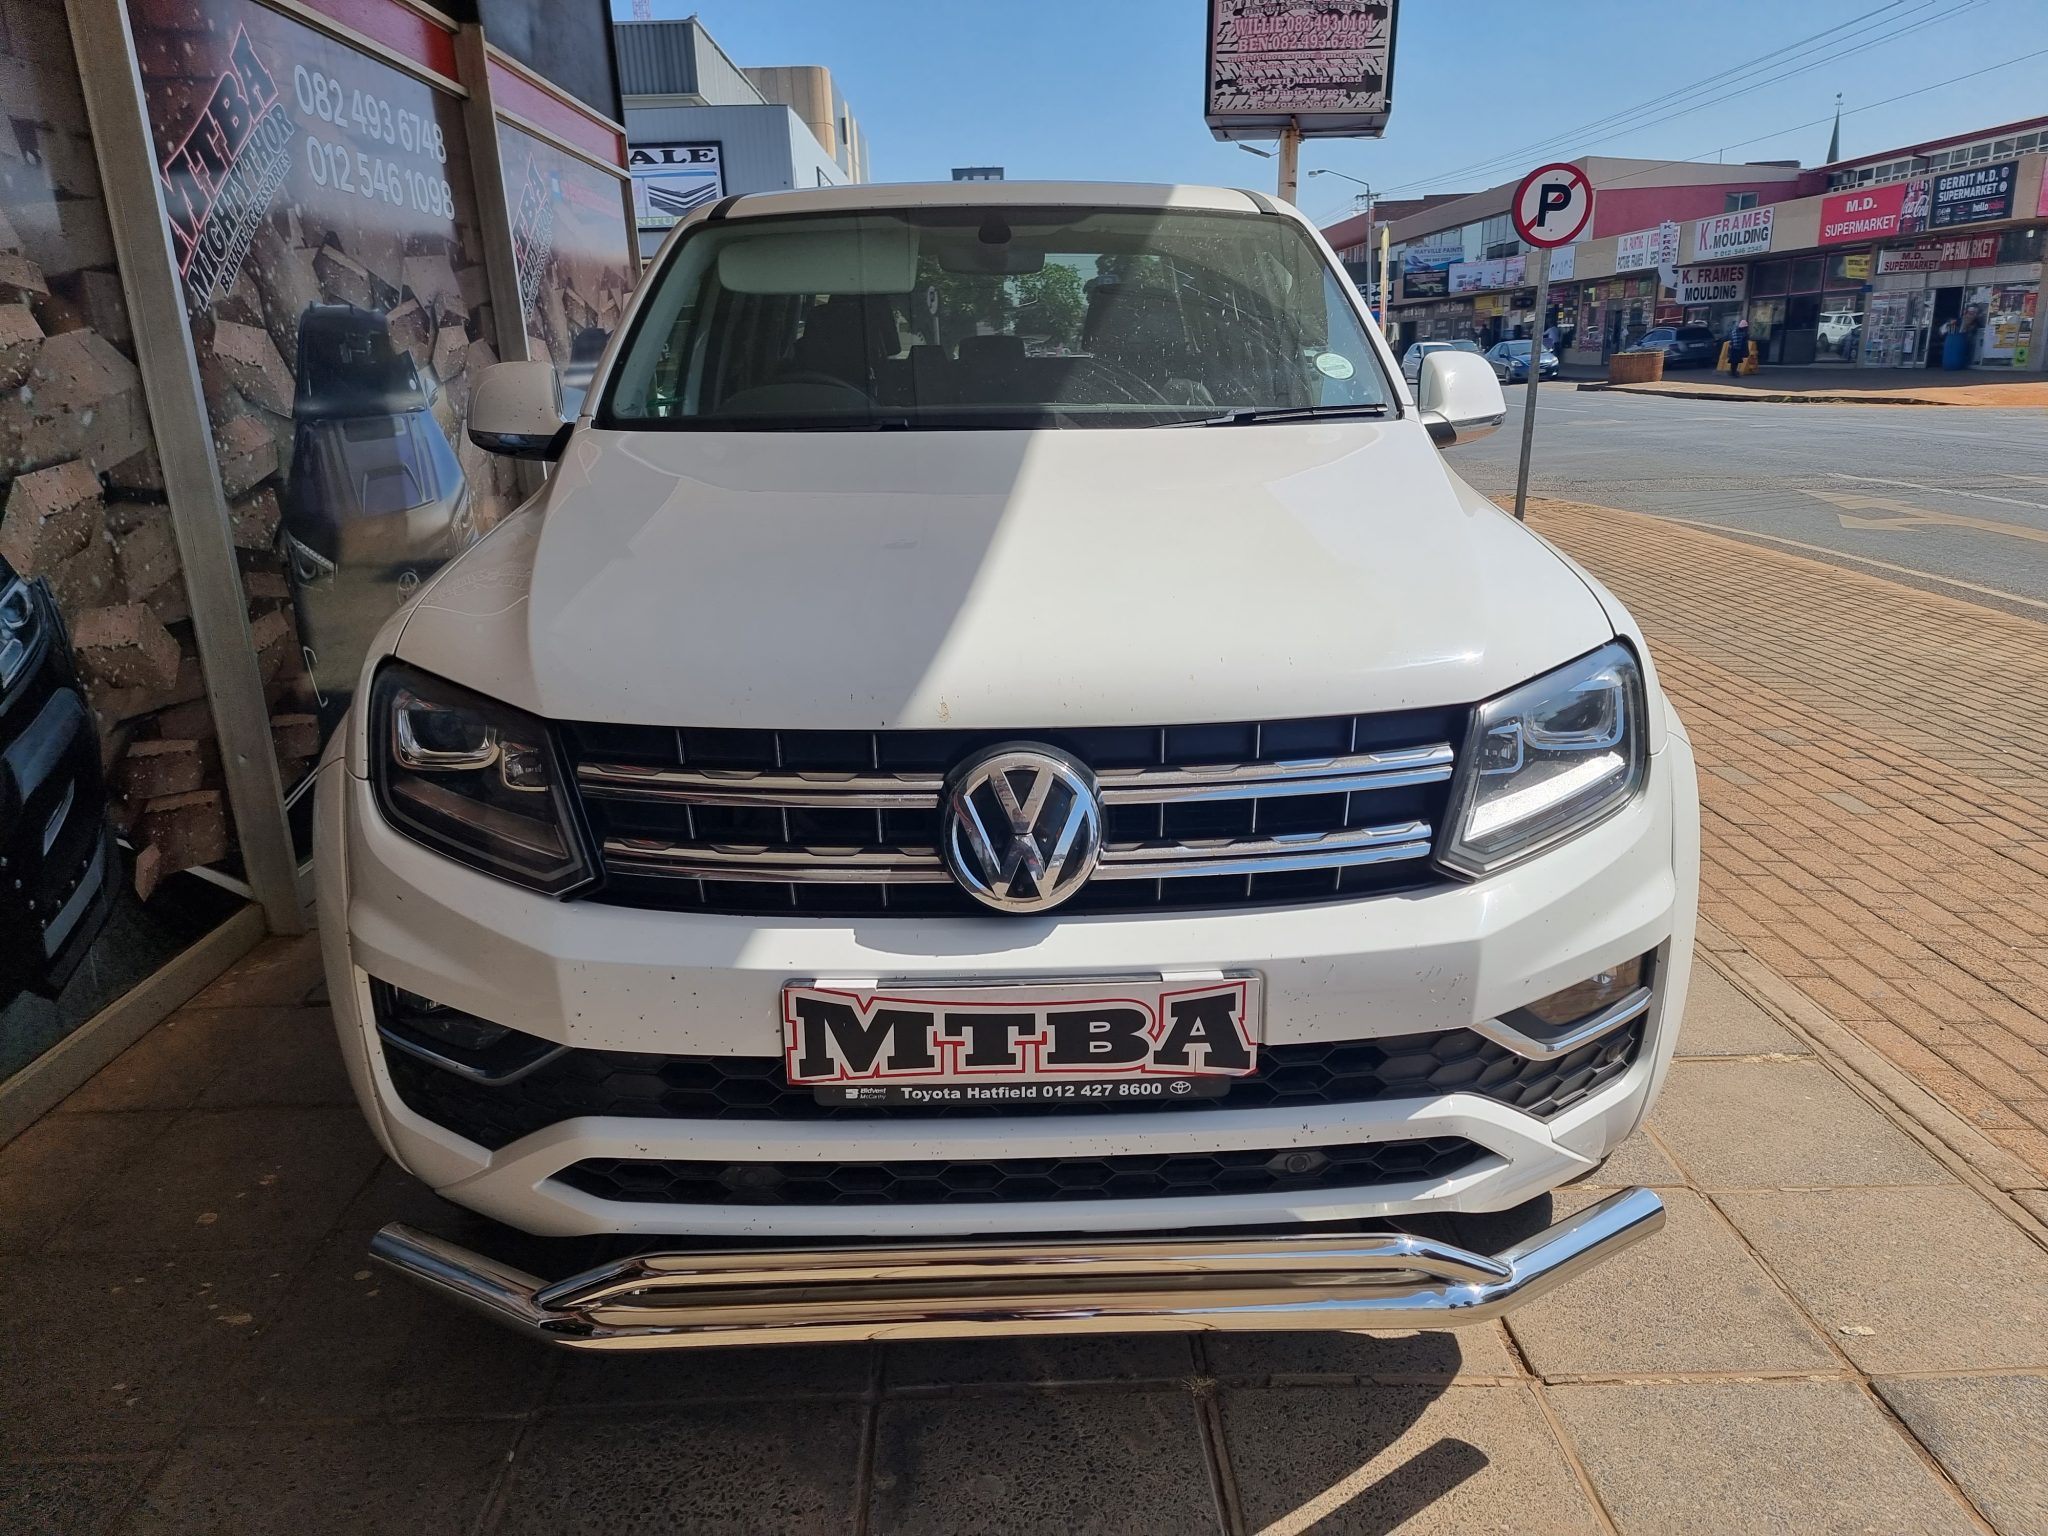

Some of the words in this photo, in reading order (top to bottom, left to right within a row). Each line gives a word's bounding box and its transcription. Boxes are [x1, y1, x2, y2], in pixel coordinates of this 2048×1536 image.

[1286, 15, 1311, 33] 082
[1314, 14, 1338, 32] 493
[1341, 13, 1374, 32] 0161
[1238, 36, 1268, 52] BEN
[1272, 34, 1298, 50] 082
[1301, 33, 1327, 49] 493
[1331, 33, 1366, 49] 6748
[294, 64, 349, 128] 082
[352, 89, 396, 145] 493
[398, 108, 447, 164] 6748
[306, 136, 356, 194] 012
[357, 152, 404, 207] 546
[405, 168, 455, 220] 1098
[1940, 173, 1975, 190] GERRIT
[1976, 169, 1999, 183] M.D.
[1938, 182, 1998, 202] SUPERMARKET
[187, 158, 255, 312] MIGHTY
[239, 103, 295, 187] THOR
[1536, 183, 1572, 227] P
[1846, 197, 1878, 212] M.D.
[1714, 209, 1771, 233] FRAMES
[1825, 215, 1896, 237] SUPERMARKET
[1713, 226, 1769, 249] MOULDING
[1661, 233, 1672, 264] FRAME
[1901, 251, 1924, 260] M.D.
[1681, 269, 1693, 284] K.
[1697, 267, 1744, 284] FRAMES
[1884, 260, 1939, 271] SUPERMARKET
[1684, 285, 1737, 301] MOULDING
[795, 993, 1252, 1078] MTBA
[901, 1086, 962, 1103] Toyota
[966, 1083, 1037, 1099] Hatfield
[1042, 1084, 1076, 1098] 012
[1080, 1083, 1115, 1098] 427
[1118, 1082, 1163, 1096] 8600
